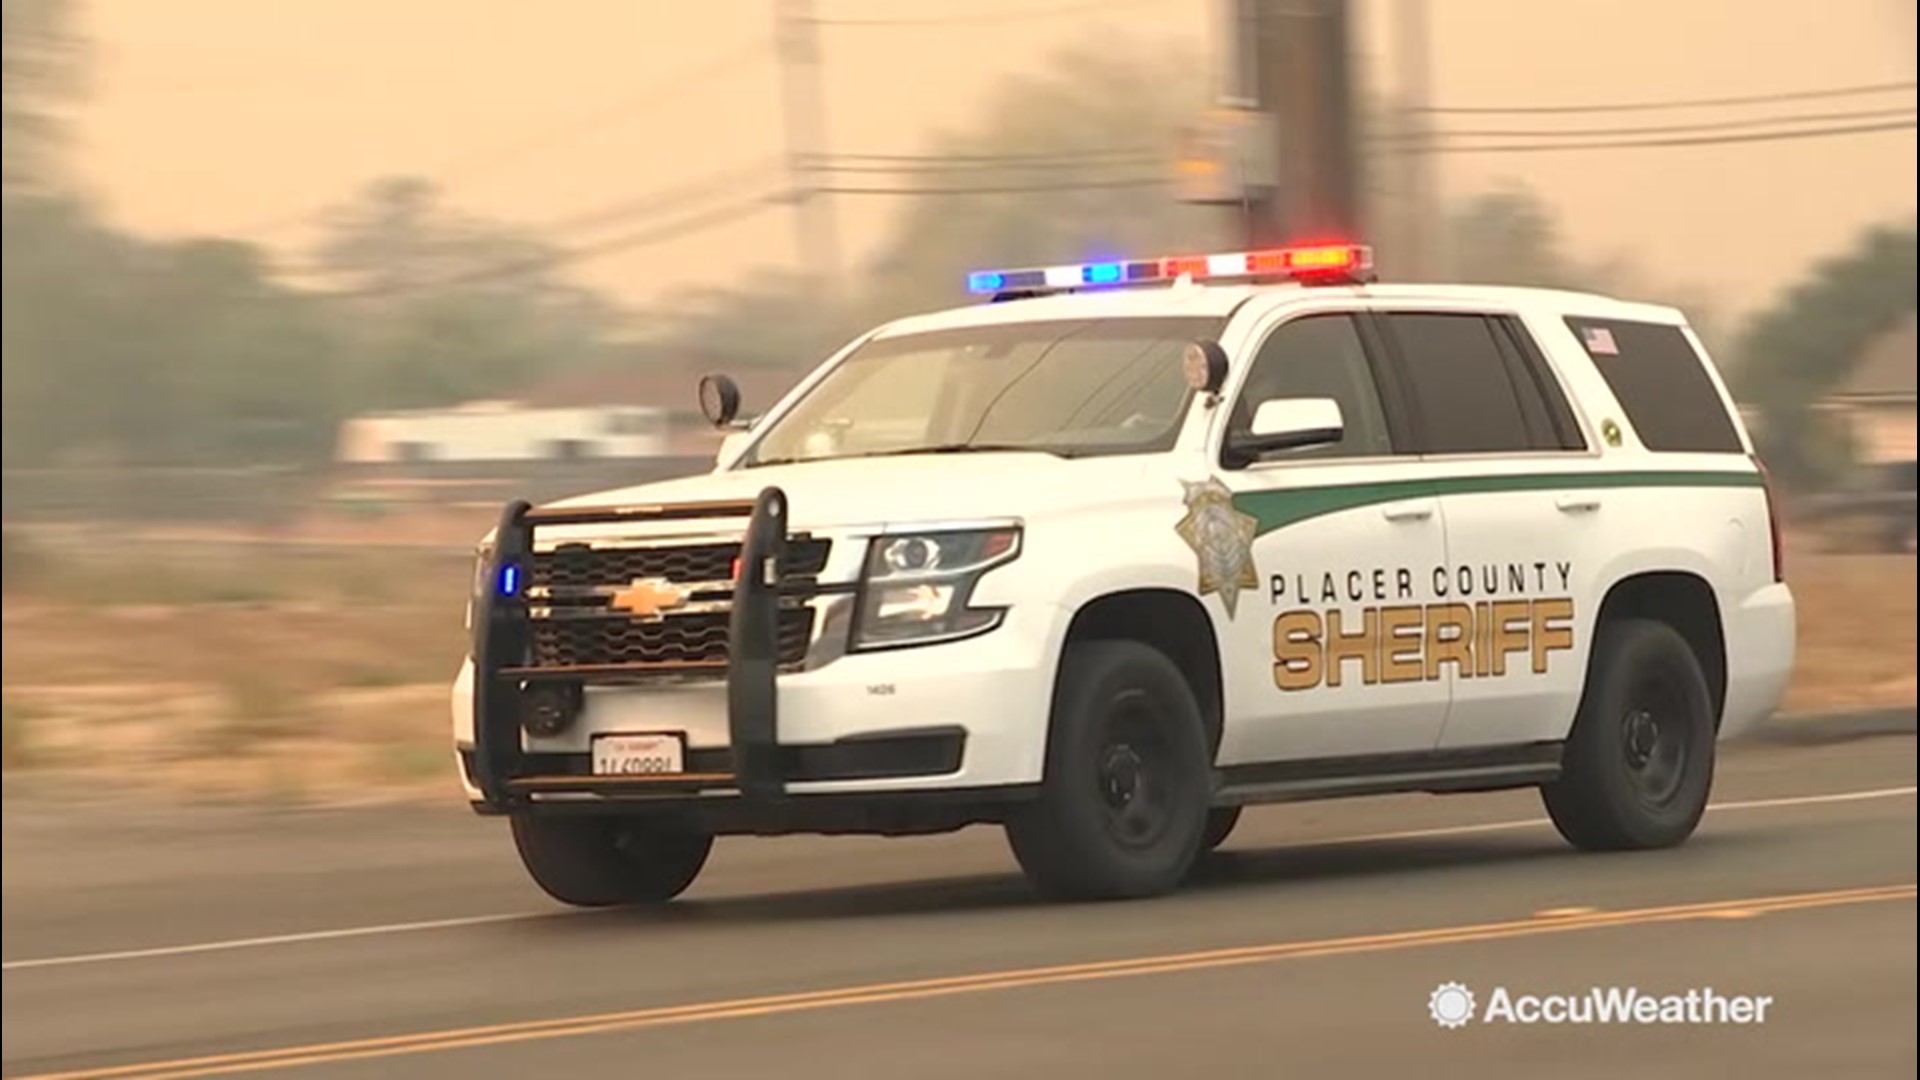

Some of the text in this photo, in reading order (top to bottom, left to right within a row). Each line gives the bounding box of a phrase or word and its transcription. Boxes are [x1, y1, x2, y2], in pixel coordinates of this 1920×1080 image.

[1270, 562, 1571, 604] PLACER COUNTY
[1272, 598, 1574, 692] SHERIFF
